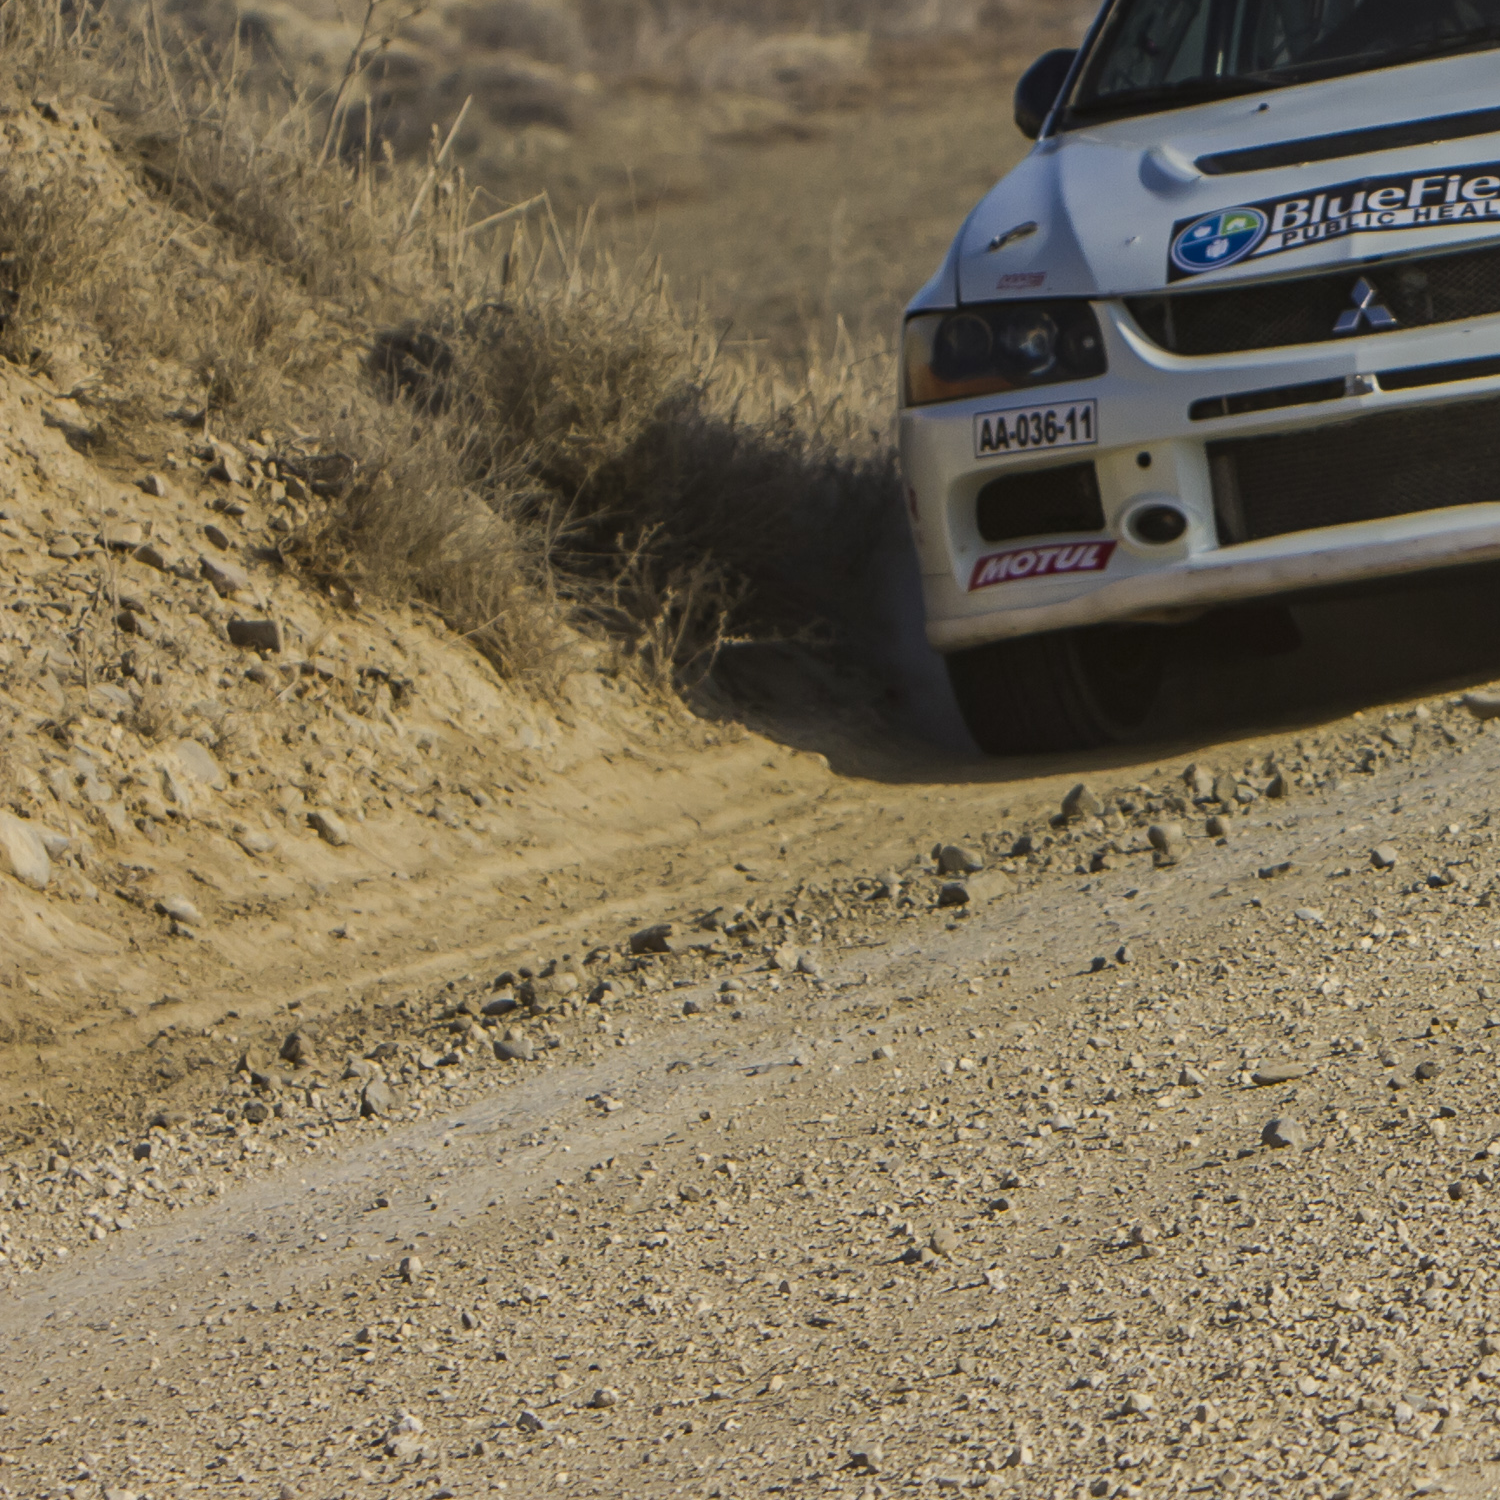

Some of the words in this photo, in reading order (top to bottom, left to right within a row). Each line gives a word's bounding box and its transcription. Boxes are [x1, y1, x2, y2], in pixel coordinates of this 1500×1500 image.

[1281, 210, 1397, 247] PUBLIC
[979, 405, 1092, 451] AA-036-11
[976, 545, 1100, 585] MOTUL
